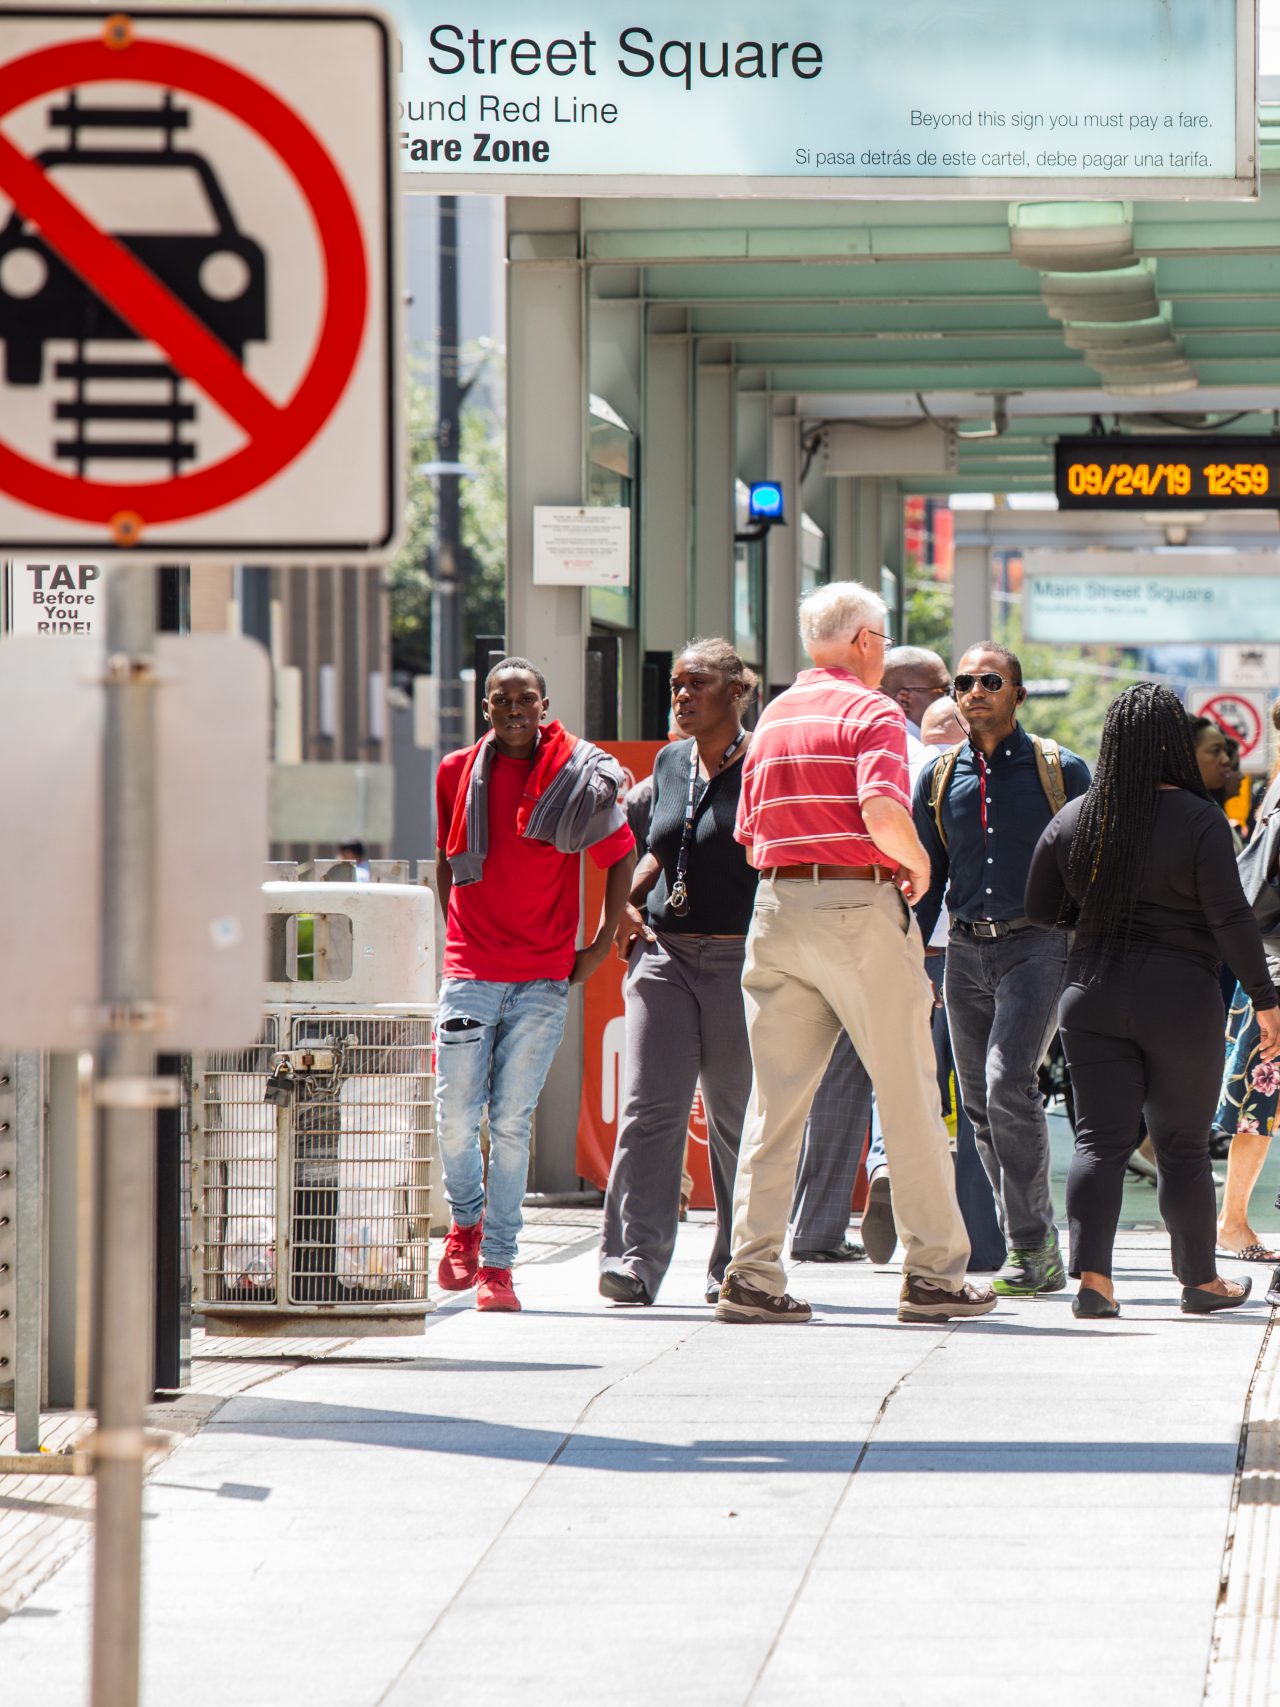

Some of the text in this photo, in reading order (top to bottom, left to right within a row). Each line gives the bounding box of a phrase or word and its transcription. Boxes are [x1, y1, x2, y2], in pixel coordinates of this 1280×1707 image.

[428, 23, 597, 77] Street
[617, 26, 824, 91] Square
[480, 94, 540, 123] Red
[554, 95, 619, 124] Line
[910, 109, 1213, 132] Beyond this sign you must pay a fare.
[473, 132, 550, 163] Zone
[795, 147, 1213, 171] Si pasa detrás de este cartel, debe pagar una tarifa.
[1068, 463, 1192, 496] 09/24/19
[1203, 463, 1269, 496] 12:59
[26, 564, 101, 590] TAP
[32, 591, 96, 605] Before
[44, 606, 79, 619] You
[37, 621, 91, 636] RIDE!
